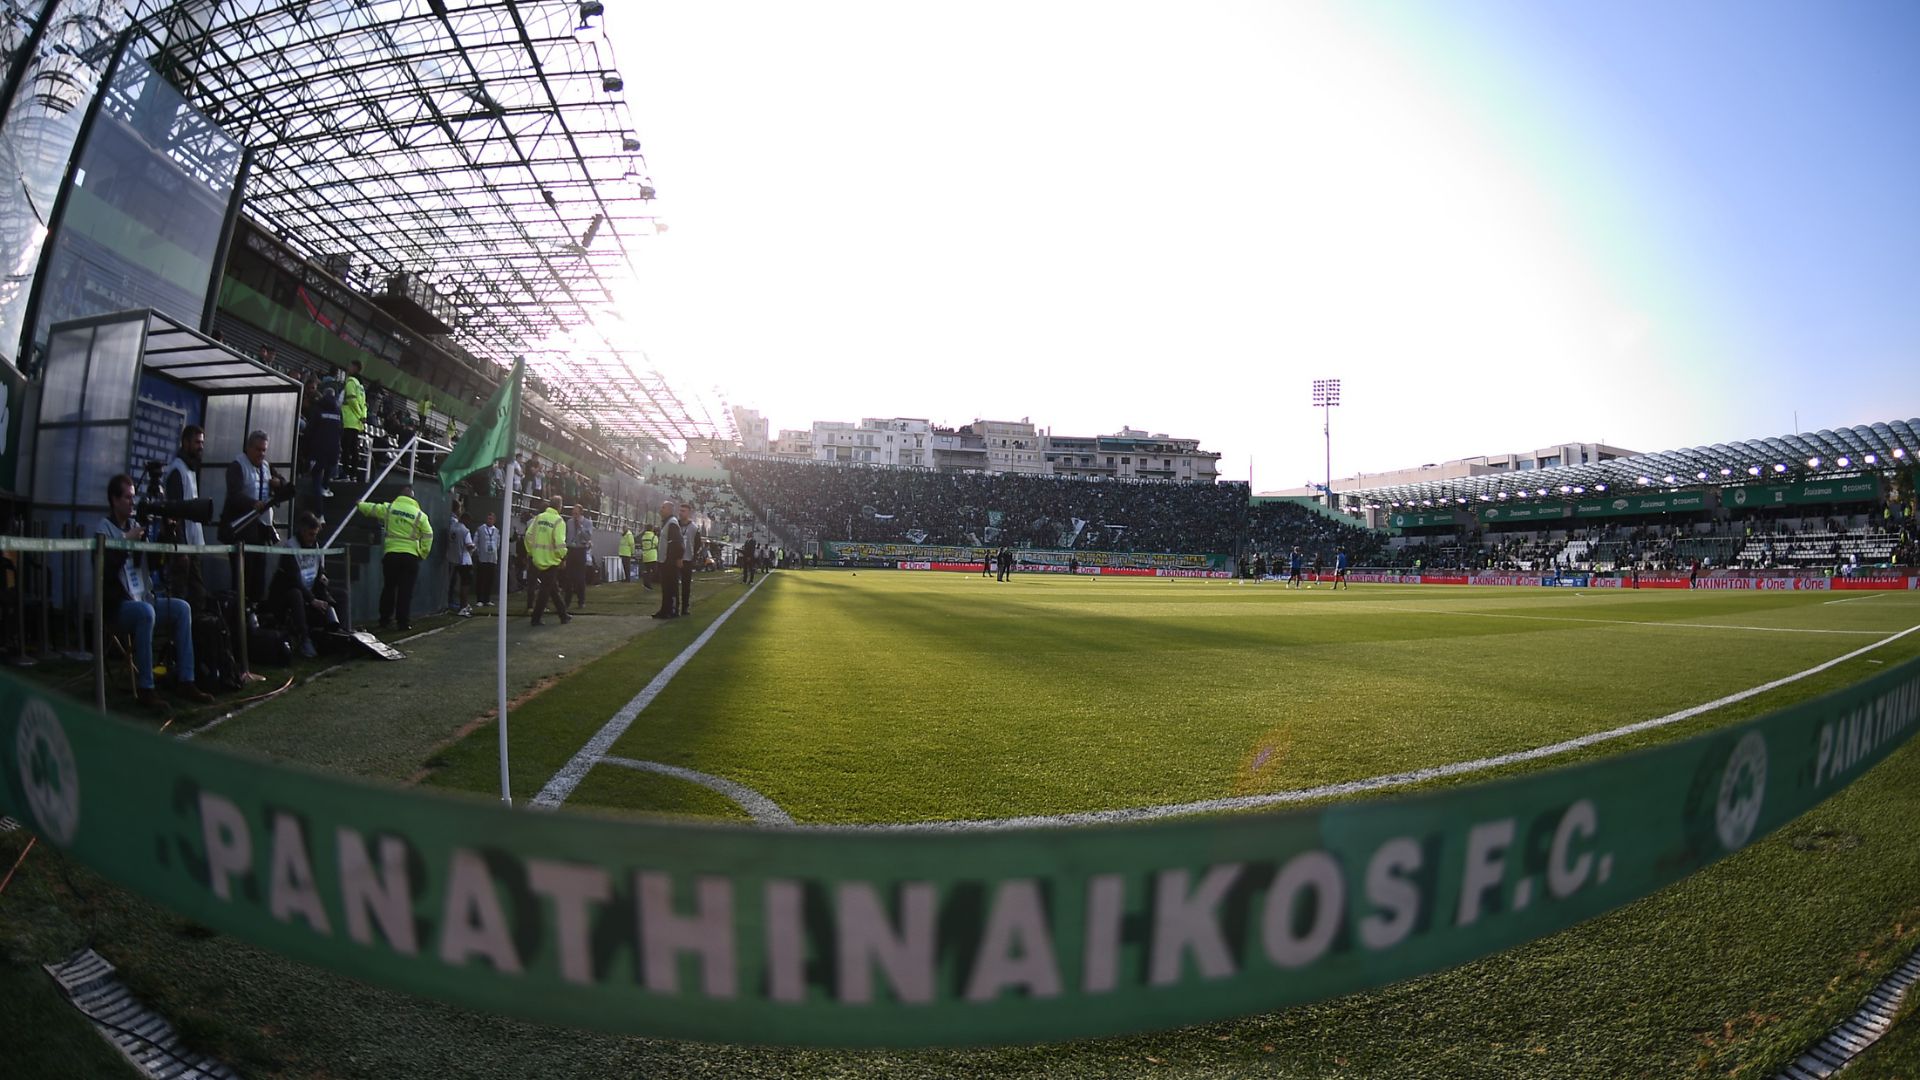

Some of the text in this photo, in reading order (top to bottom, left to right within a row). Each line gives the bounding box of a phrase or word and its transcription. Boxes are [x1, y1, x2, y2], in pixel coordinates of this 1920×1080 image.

[1766, 579, 1785, 590] One
[1804, 579, 1824, 590] One
[199, 790, 1614, 1005] PANATHINAIKOS F.C.
